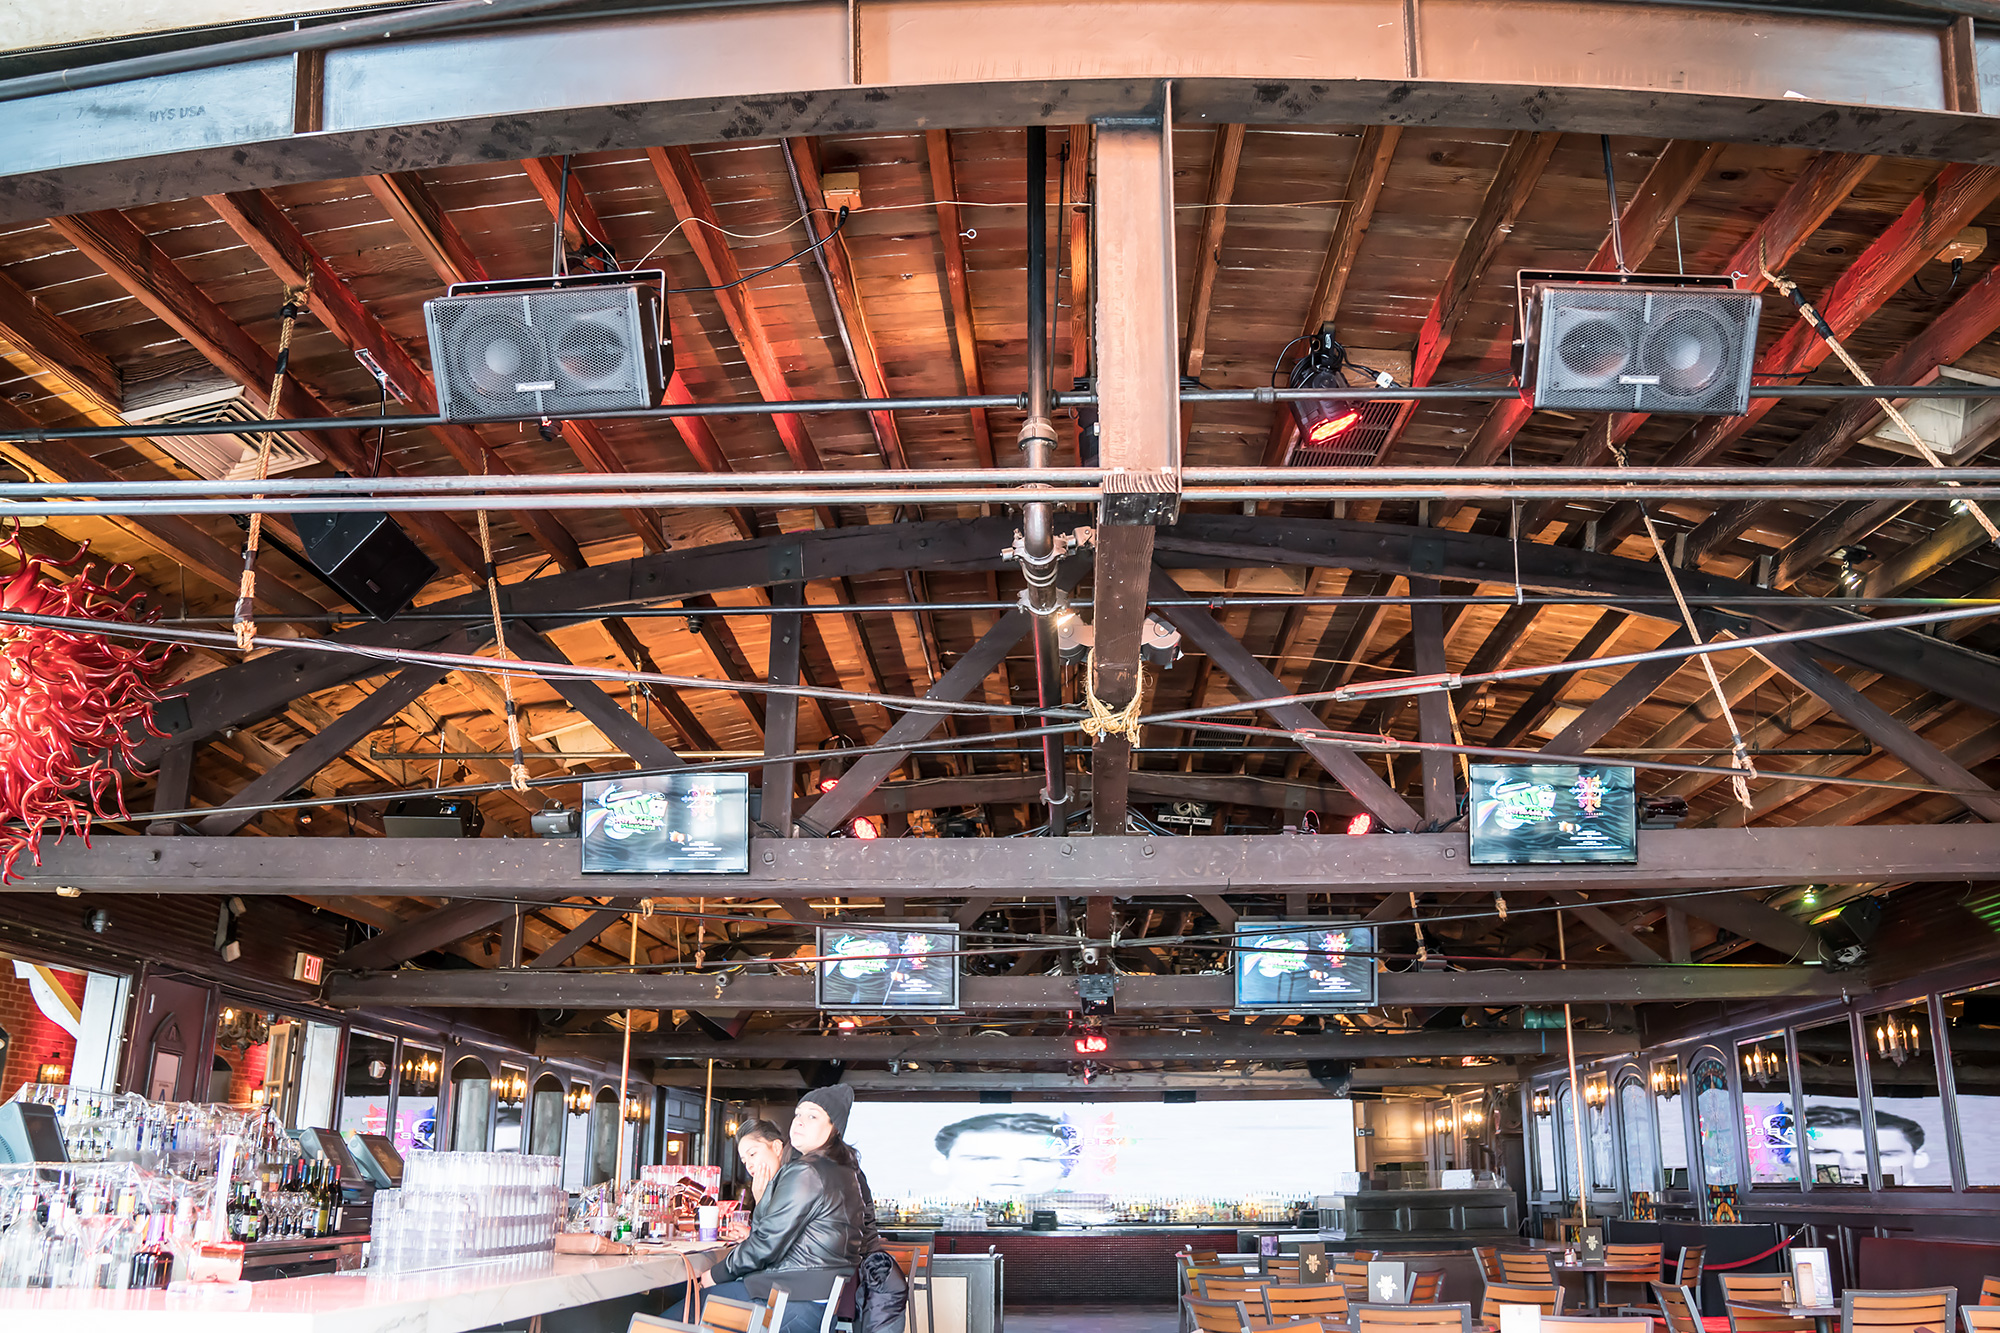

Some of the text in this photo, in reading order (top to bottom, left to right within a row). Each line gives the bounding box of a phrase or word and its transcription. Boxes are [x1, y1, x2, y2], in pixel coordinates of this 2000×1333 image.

[180, 105, 206, 118] USA
[518, 382, 554, 391] Pioneer
[606, 794, 653, 816] TNT
[1496, 785, 1541, 806] TNT
[304, 954, 322, 981] EXIT
[1050, 1124, 1121, 1159] 25
[1051, 1137, 1123, 1146] ABBEY
